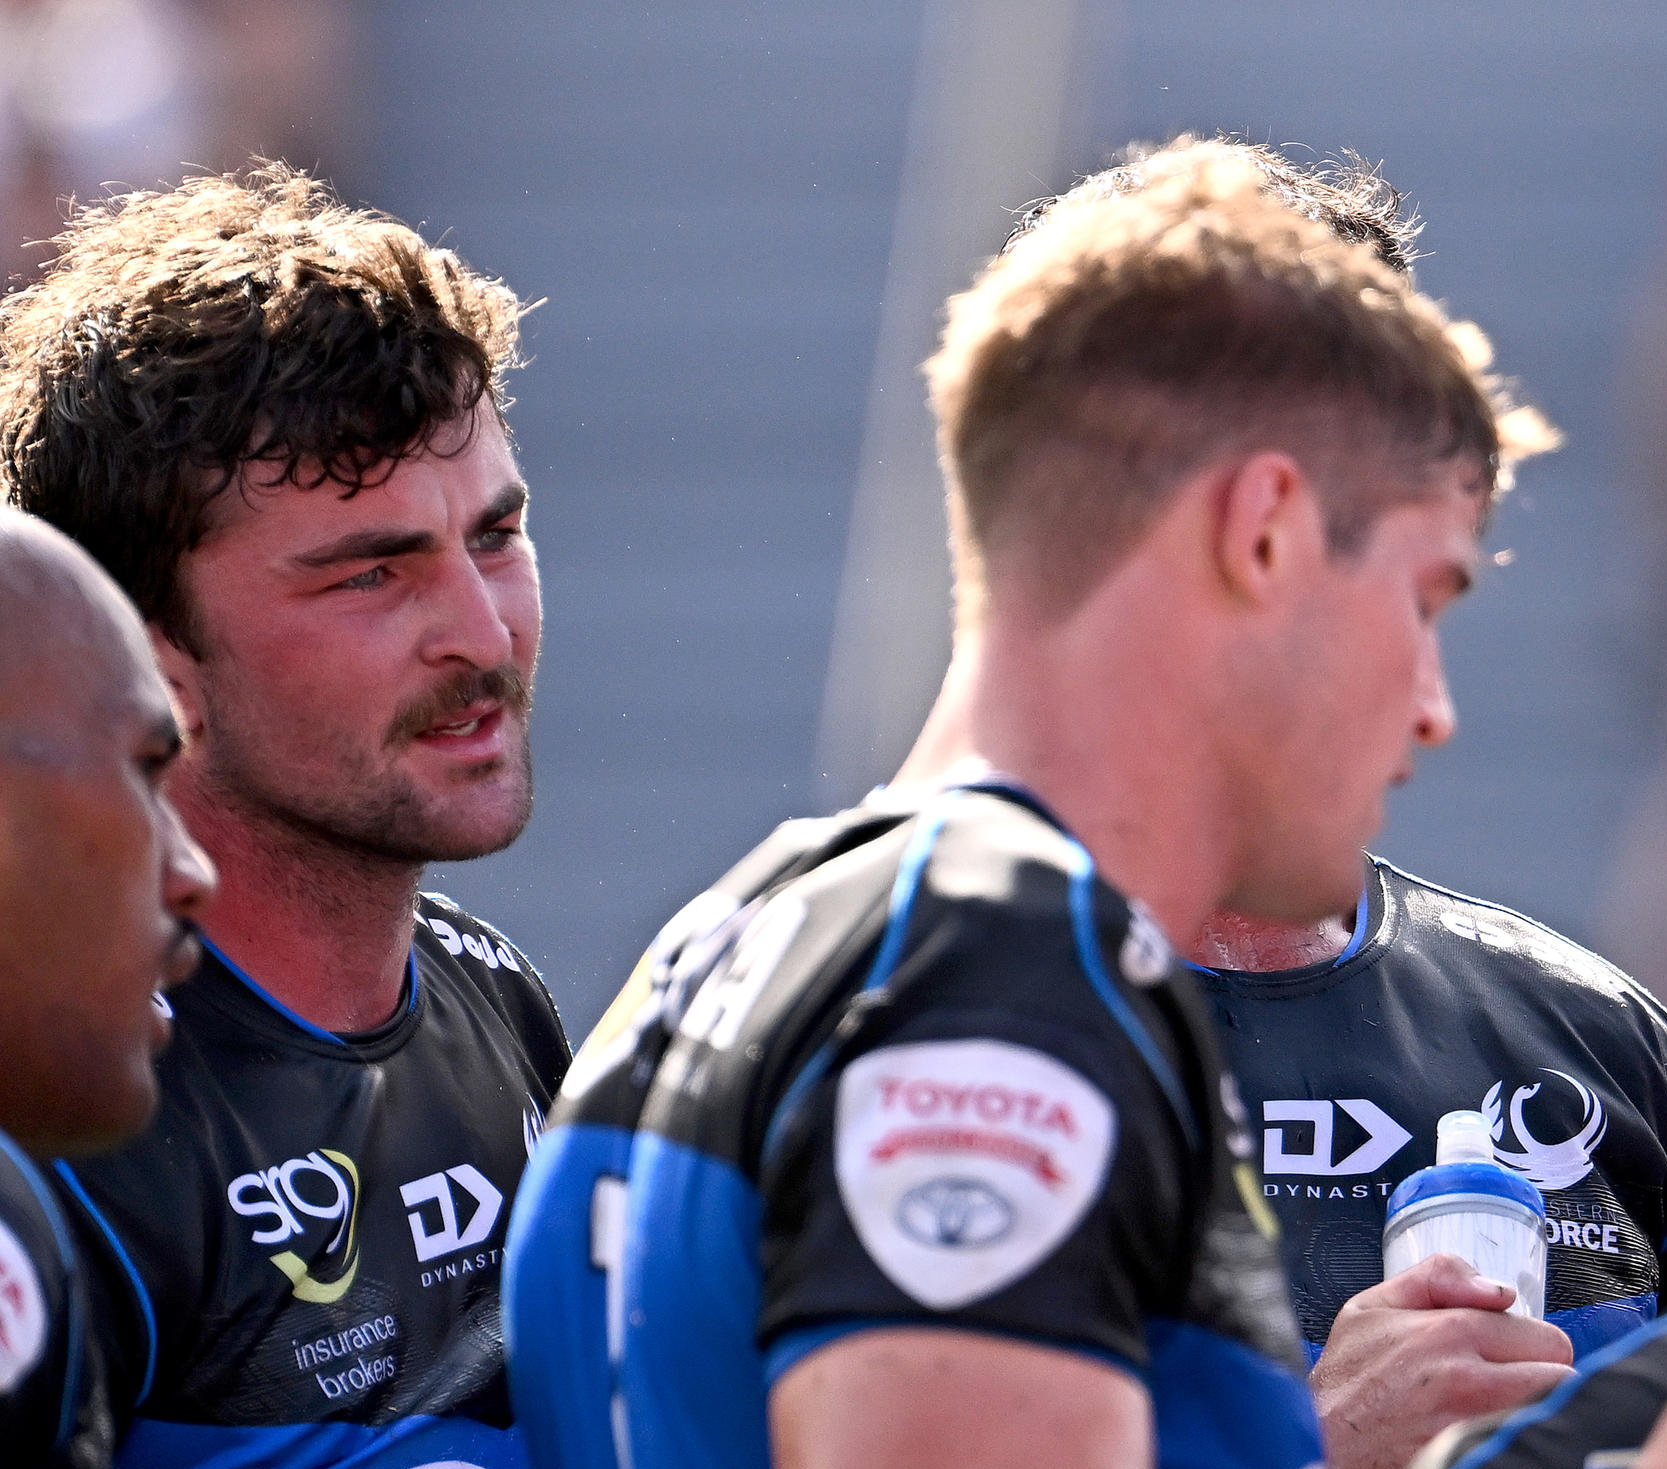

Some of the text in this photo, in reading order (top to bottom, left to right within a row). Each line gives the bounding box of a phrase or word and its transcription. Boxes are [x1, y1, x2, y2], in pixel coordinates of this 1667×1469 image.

[877, 1077, 1078, 1143] TOYOTA
[1549, 1199, 1618, 1223] STERN
[1545, 1218, 1621, 1253] ORCE
[292, 1314, 397, 1370] insurance
[315, 1354, 396, 1400] brokers
